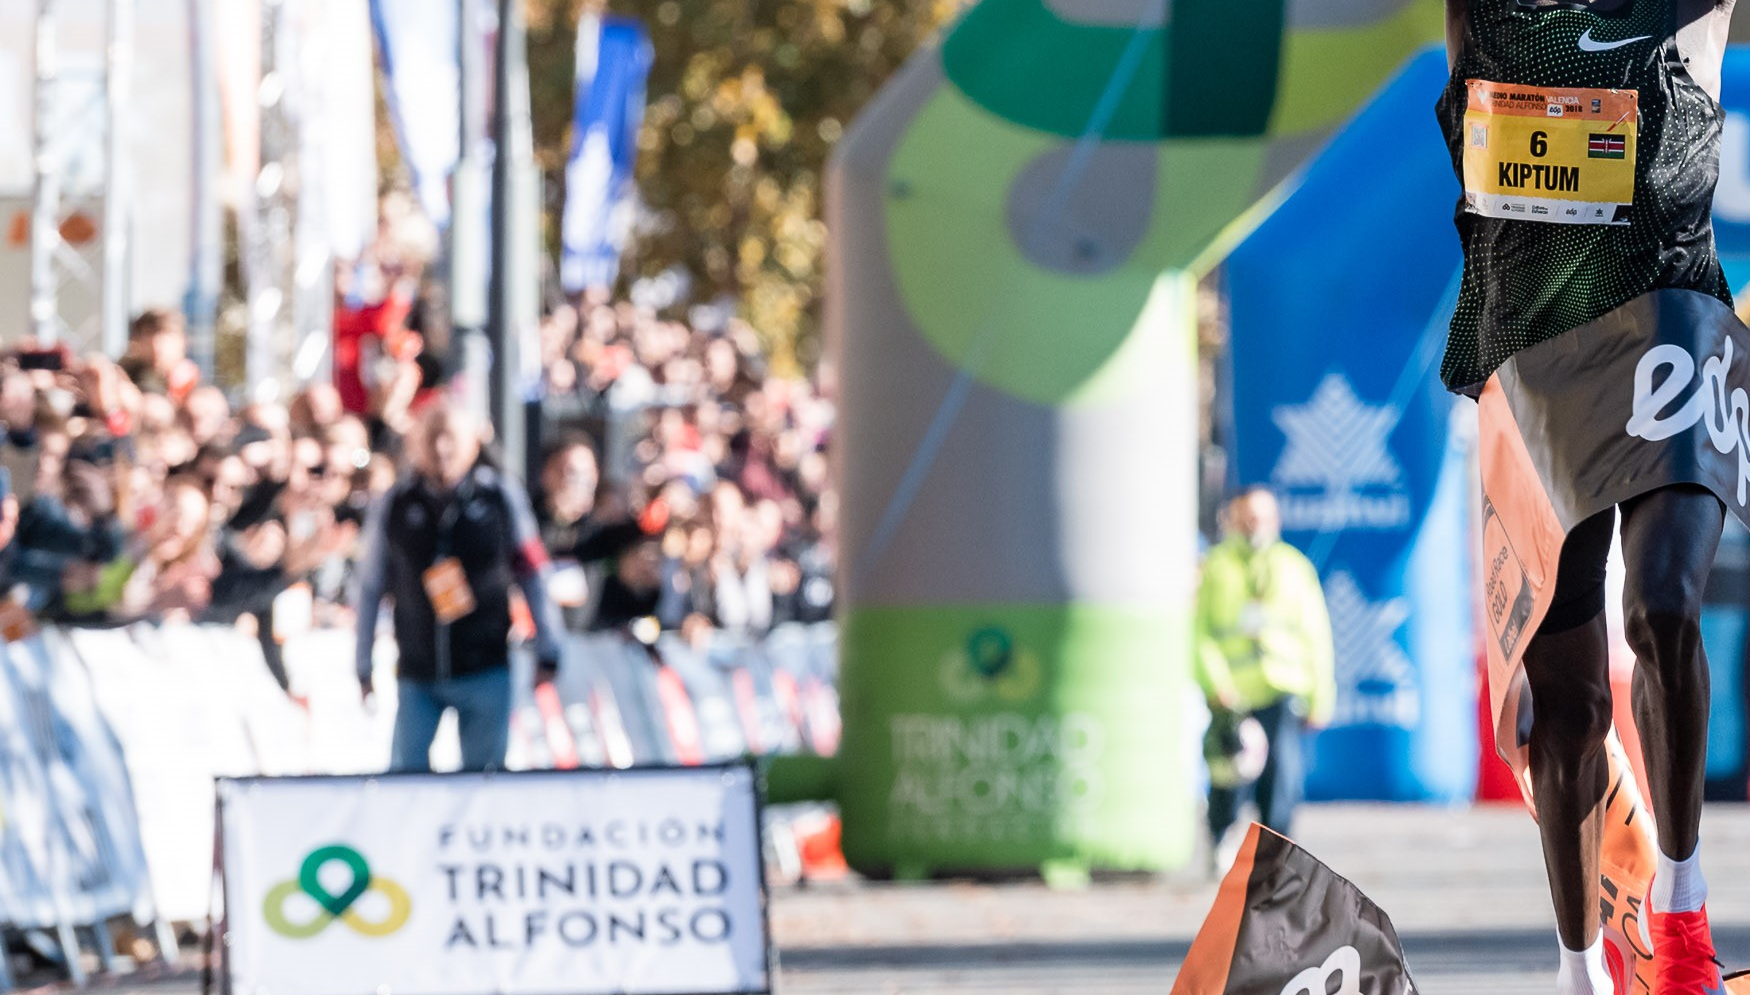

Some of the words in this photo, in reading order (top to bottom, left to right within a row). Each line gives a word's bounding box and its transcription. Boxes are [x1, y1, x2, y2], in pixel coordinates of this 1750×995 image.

[1510, 92, 1546, 102] MARATÓN
[1546, 95, 1579, 104] VALENCIA
[1516, 101, 1547, 111] ALFONSO
[1565, 105, 1583, 113] 2018
[1530, 131, 1548, 158] 6
[1498, 161, 1580, 193] KIPTUM
[437, 818, 727, 850] FUNDACIÓN
[436, 859, 730, 900] TRINIDAD
[446, 907, 734, 949] ALFONSO
